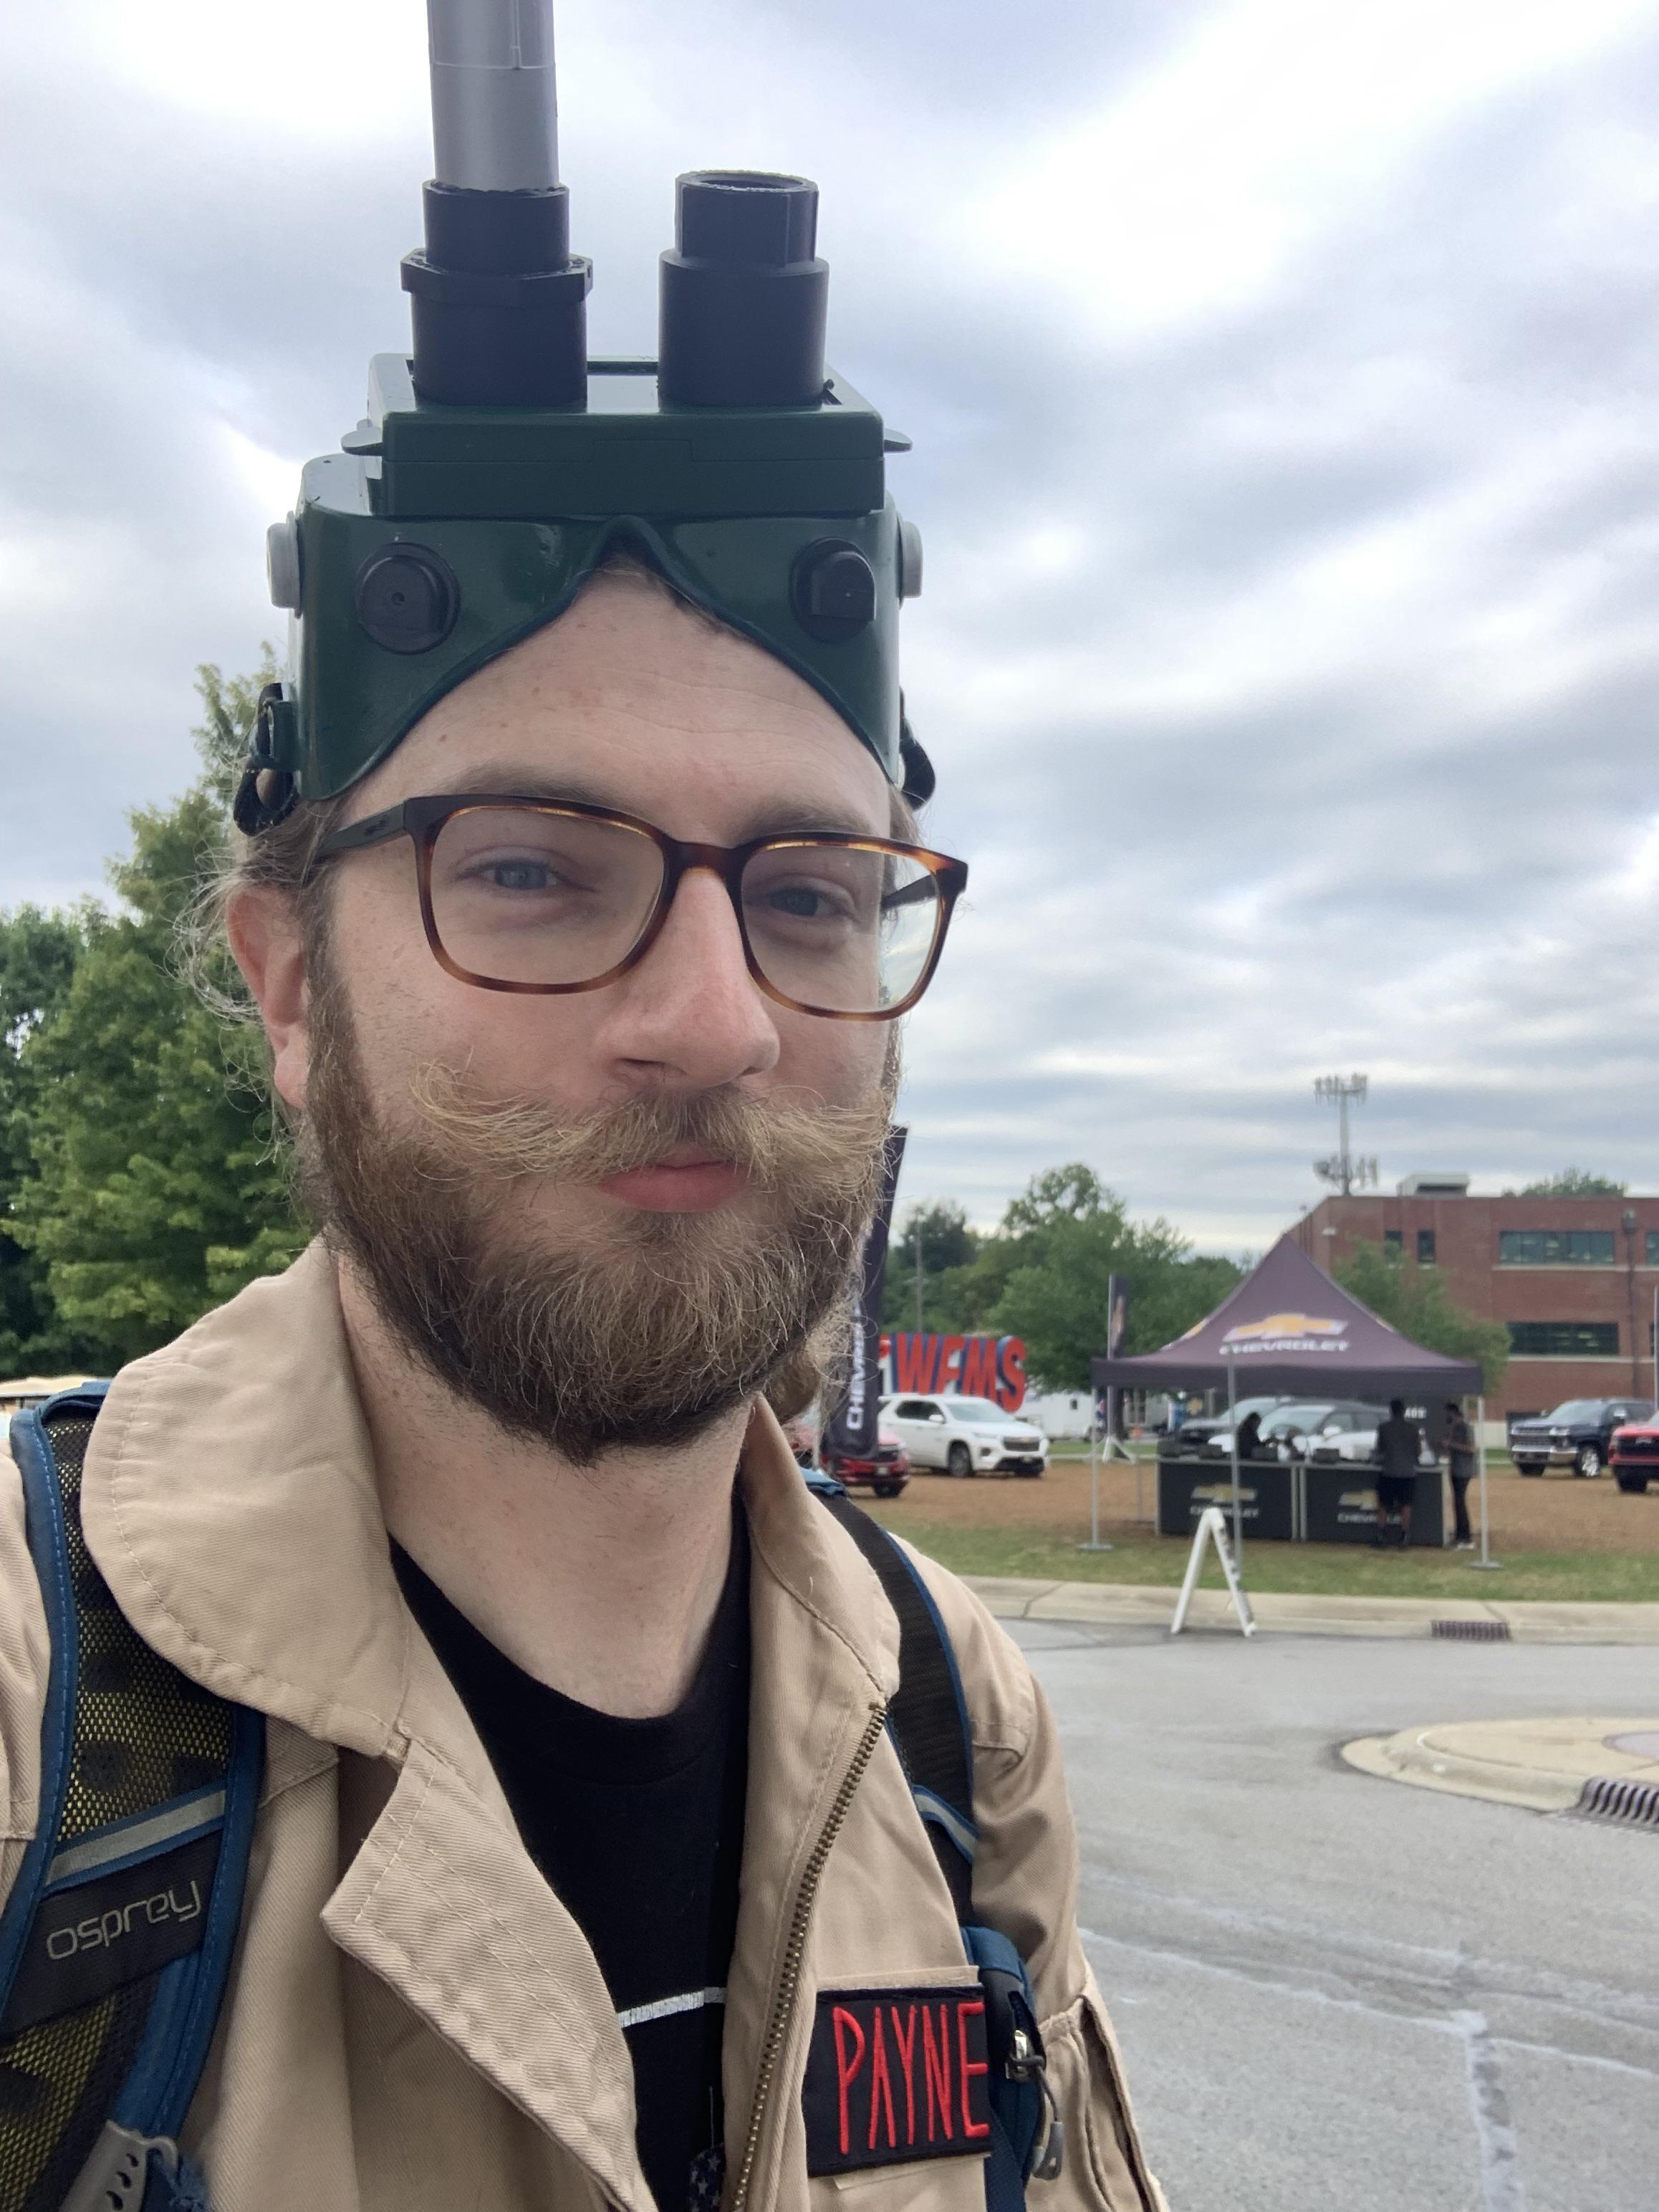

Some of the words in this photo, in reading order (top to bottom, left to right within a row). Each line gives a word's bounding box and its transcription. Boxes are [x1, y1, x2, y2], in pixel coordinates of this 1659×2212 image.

[893, 1332, 1026, 1413] WFMS
[47, 1880, 201, 1960] osprey
[832, 2001, 990, 2155] PAYNE
